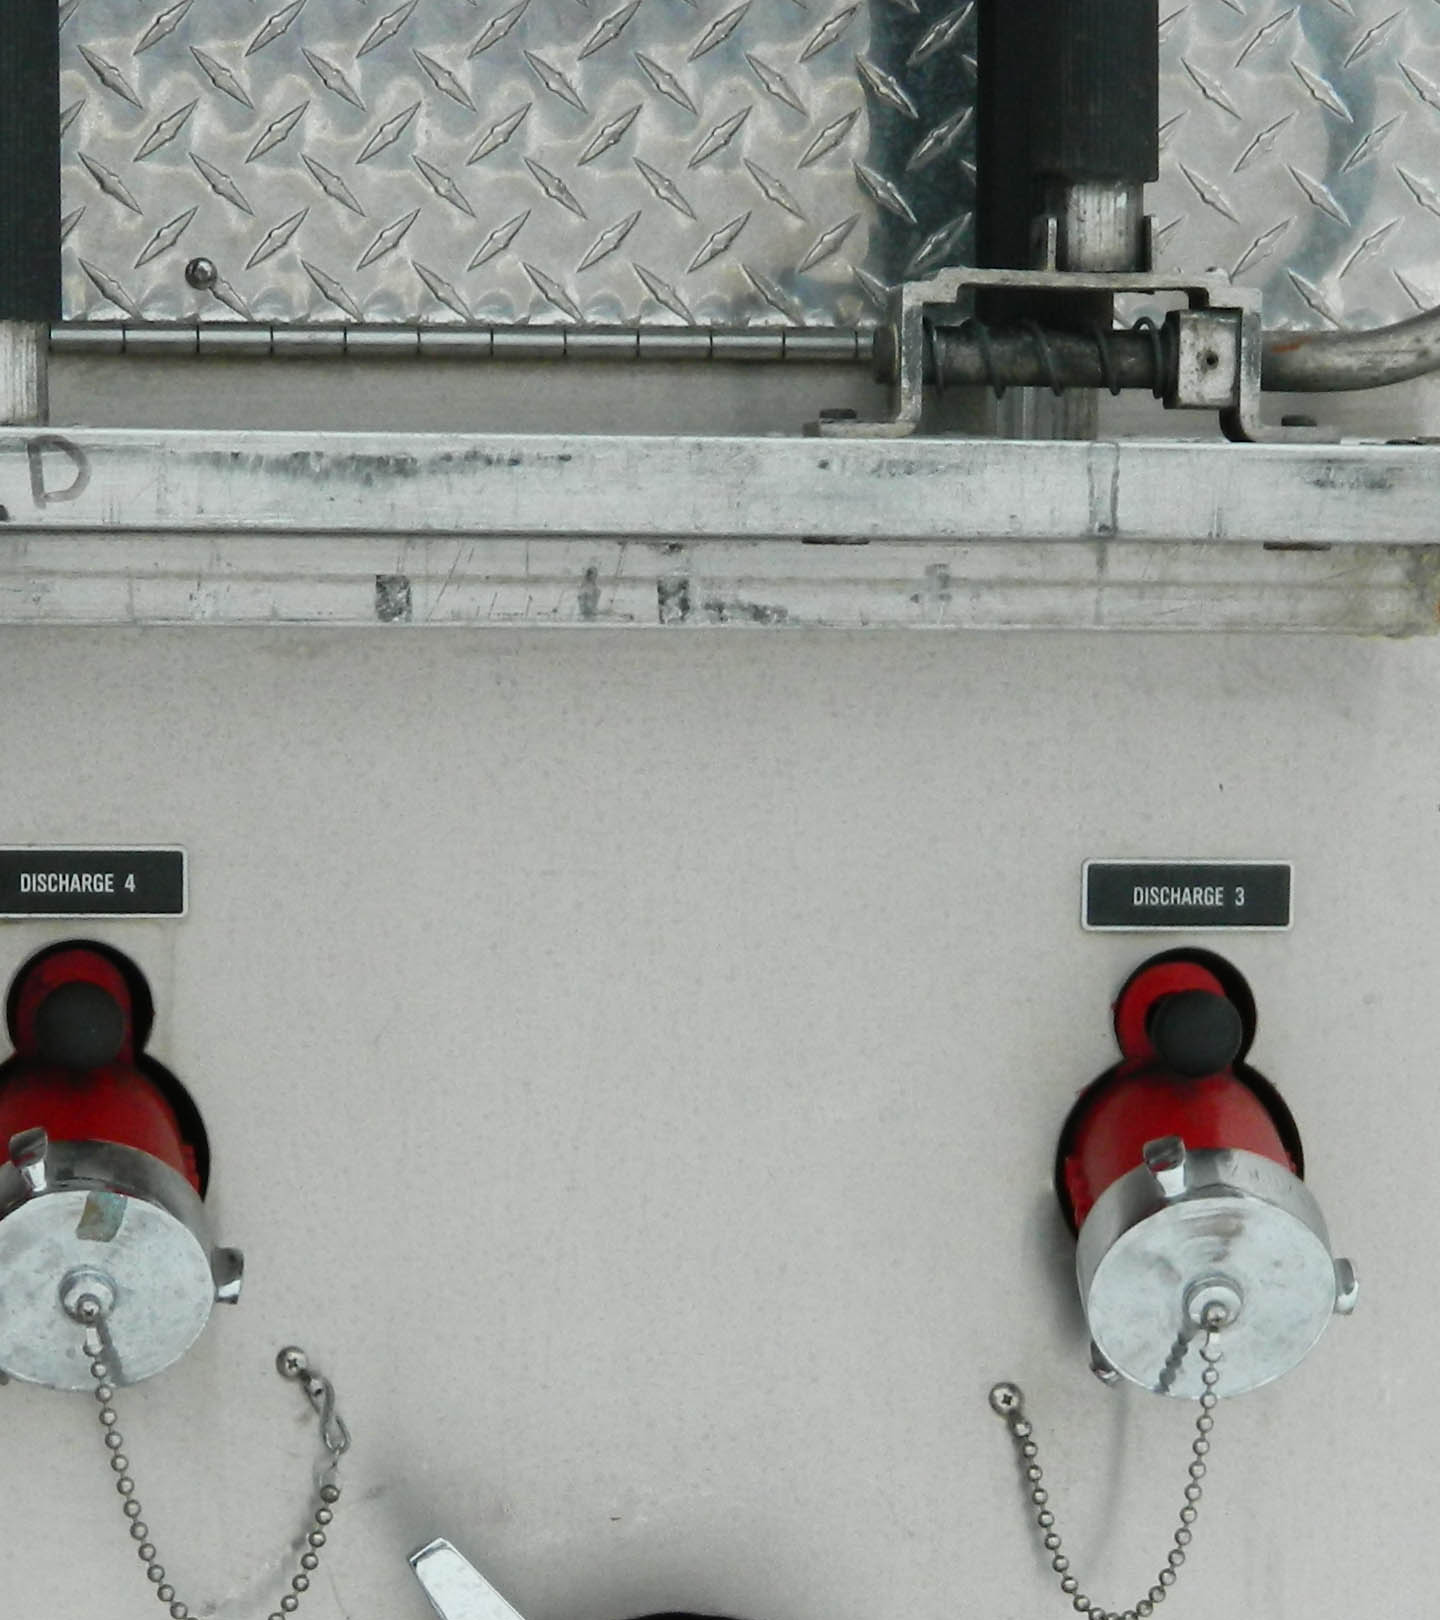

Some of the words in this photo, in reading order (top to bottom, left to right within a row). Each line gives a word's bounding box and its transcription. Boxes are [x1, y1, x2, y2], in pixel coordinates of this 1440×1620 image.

[20, 873, 115, 893] DISCHARGE
[124, 873, 137, 893] 4
[1132, 886, 1225, 907] DISCHARGE
[1234, 886, 1246, 907] 3
